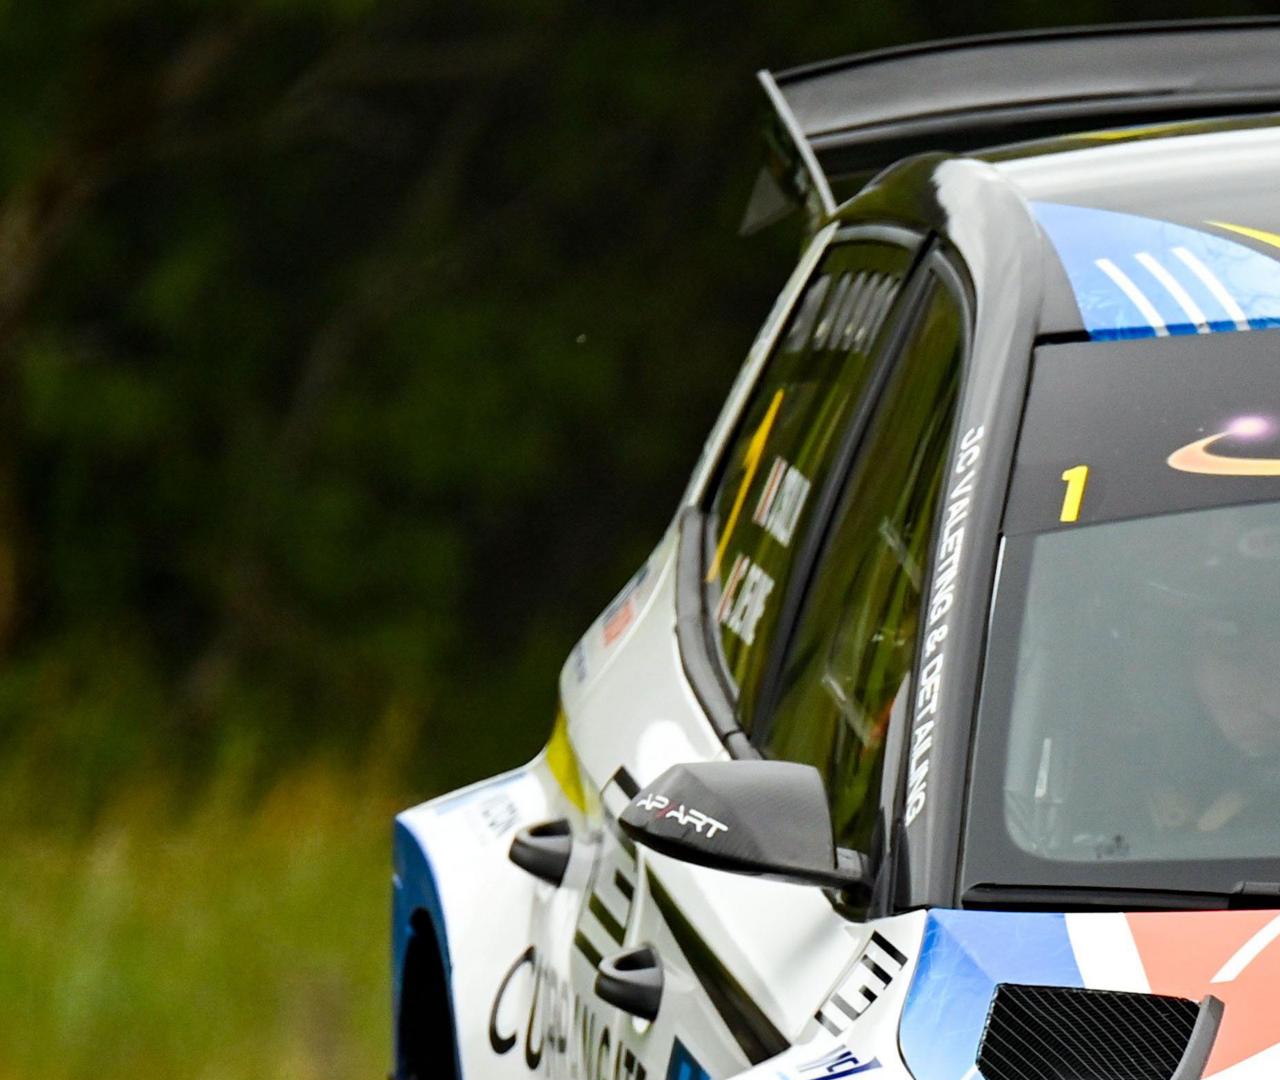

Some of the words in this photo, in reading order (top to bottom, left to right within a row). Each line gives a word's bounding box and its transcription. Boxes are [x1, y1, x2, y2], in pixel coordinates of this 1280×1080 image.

[1059, 465, 1088, 522] 1
[928, 469, 976, 626] VALETING
[925, 624, 949, 657] &
[904, 652, 944, 828] DETAILING
